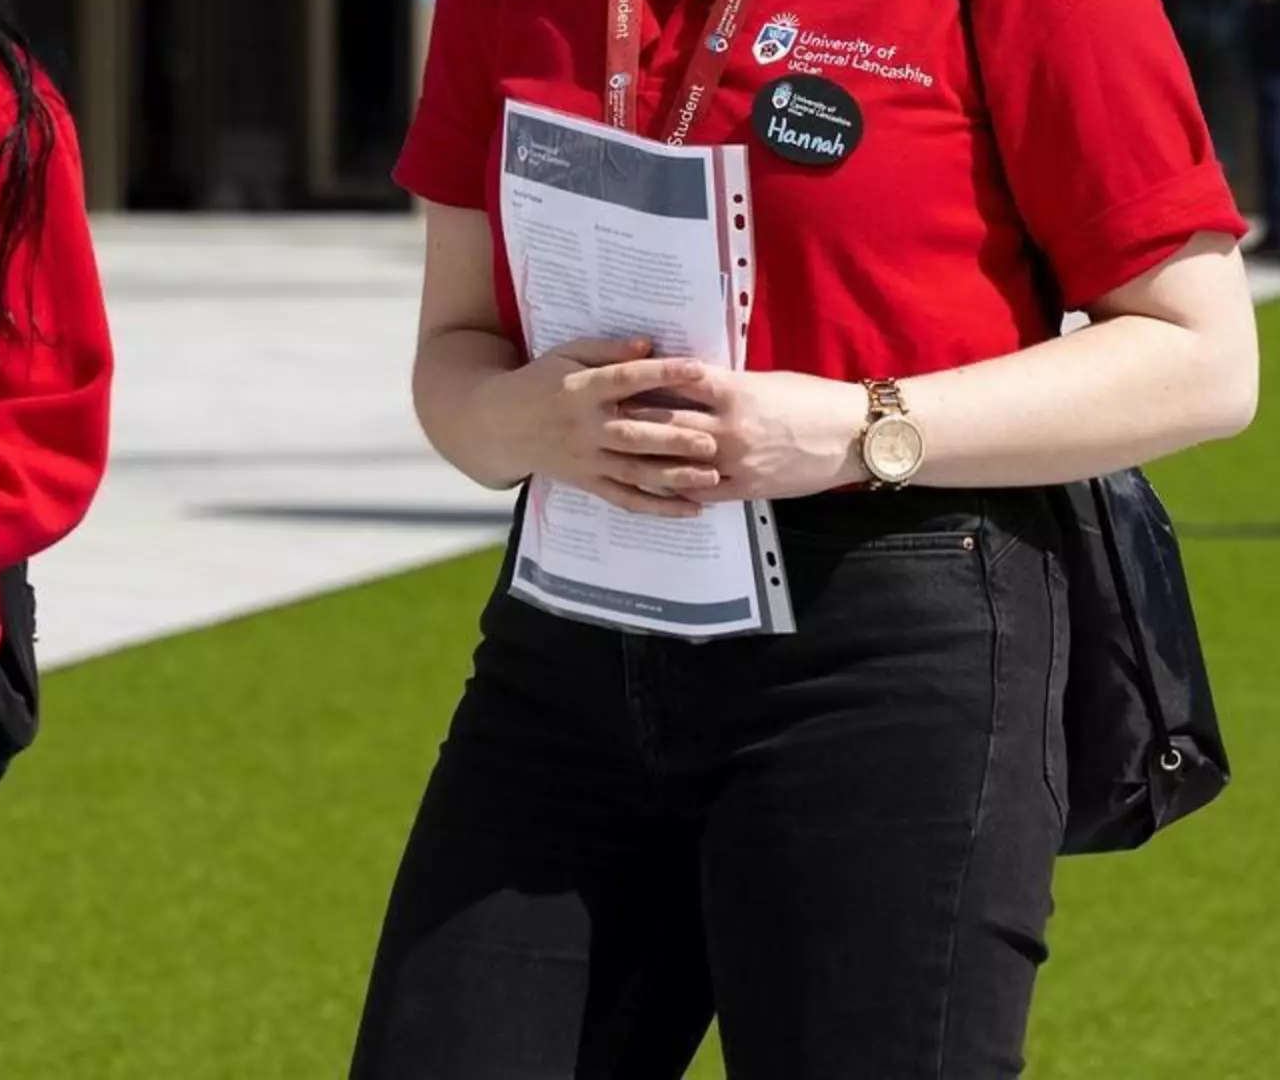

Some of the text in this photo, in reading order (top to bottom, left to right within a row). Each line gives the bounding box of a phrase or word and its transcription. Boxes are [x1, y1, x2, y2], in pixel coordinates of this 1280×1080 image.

[793, 45, 933, 88] Central Lancashire
[799, 31, 898, 62] University of
[667, 84, 705, 149] Student
[768, 116, 844, 156] Hannah
